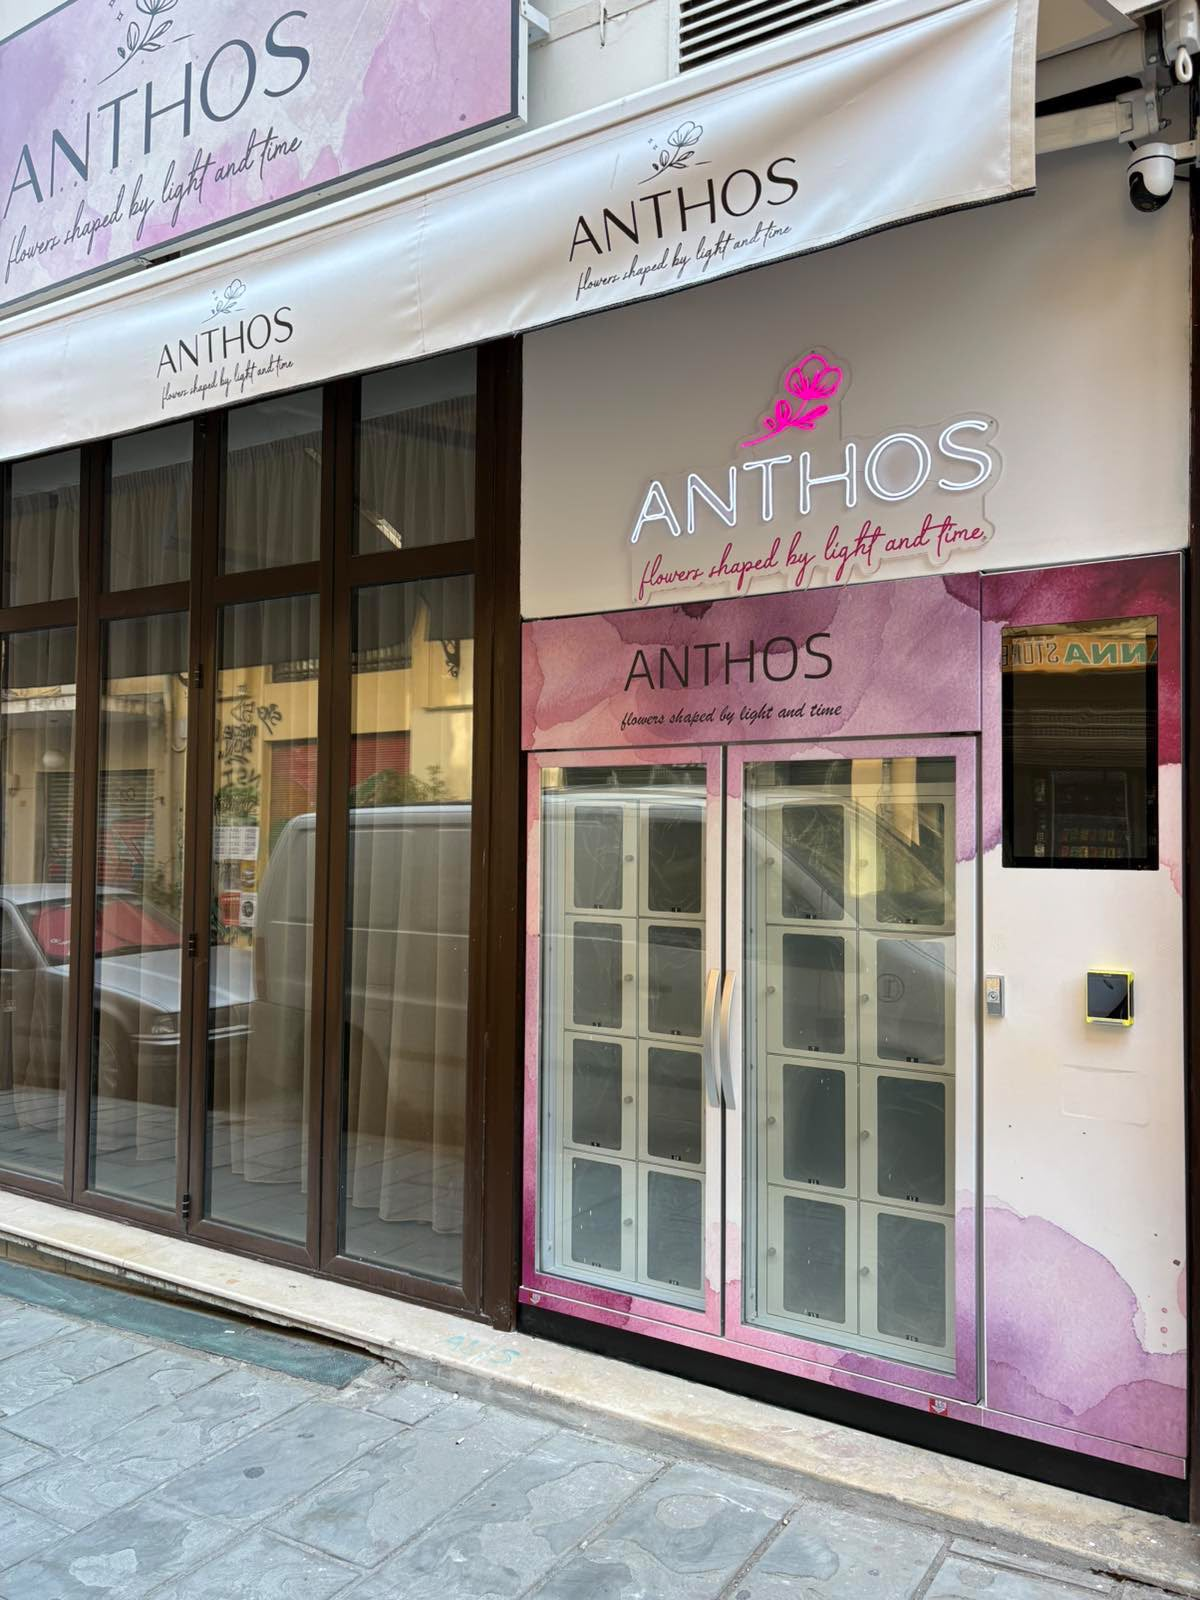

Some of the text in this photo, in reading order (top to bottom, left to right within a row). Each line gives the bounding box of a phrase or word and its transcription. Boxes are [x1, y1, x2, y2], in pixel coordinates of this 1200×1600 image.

[3, 10, 310, 219] ANTHOS
[4, 126, 303, 284] flowers shaped by light and time
[569, 157, 799, 262] ANTHOS
[575, 219, 793, 301] flowers shaped by light and time
[157, 306, 293, 378] ANTHOS
[162, 354, 294, 410] flowers shaped by light and time
[630, 419, 993, 544] ANTHOS
[638, 513, 986, 601] flowers shaped by light and time
[623, 632, 833, 692] ANTHOS
[620, 702, 842, 731] flowers shaped by light and time
